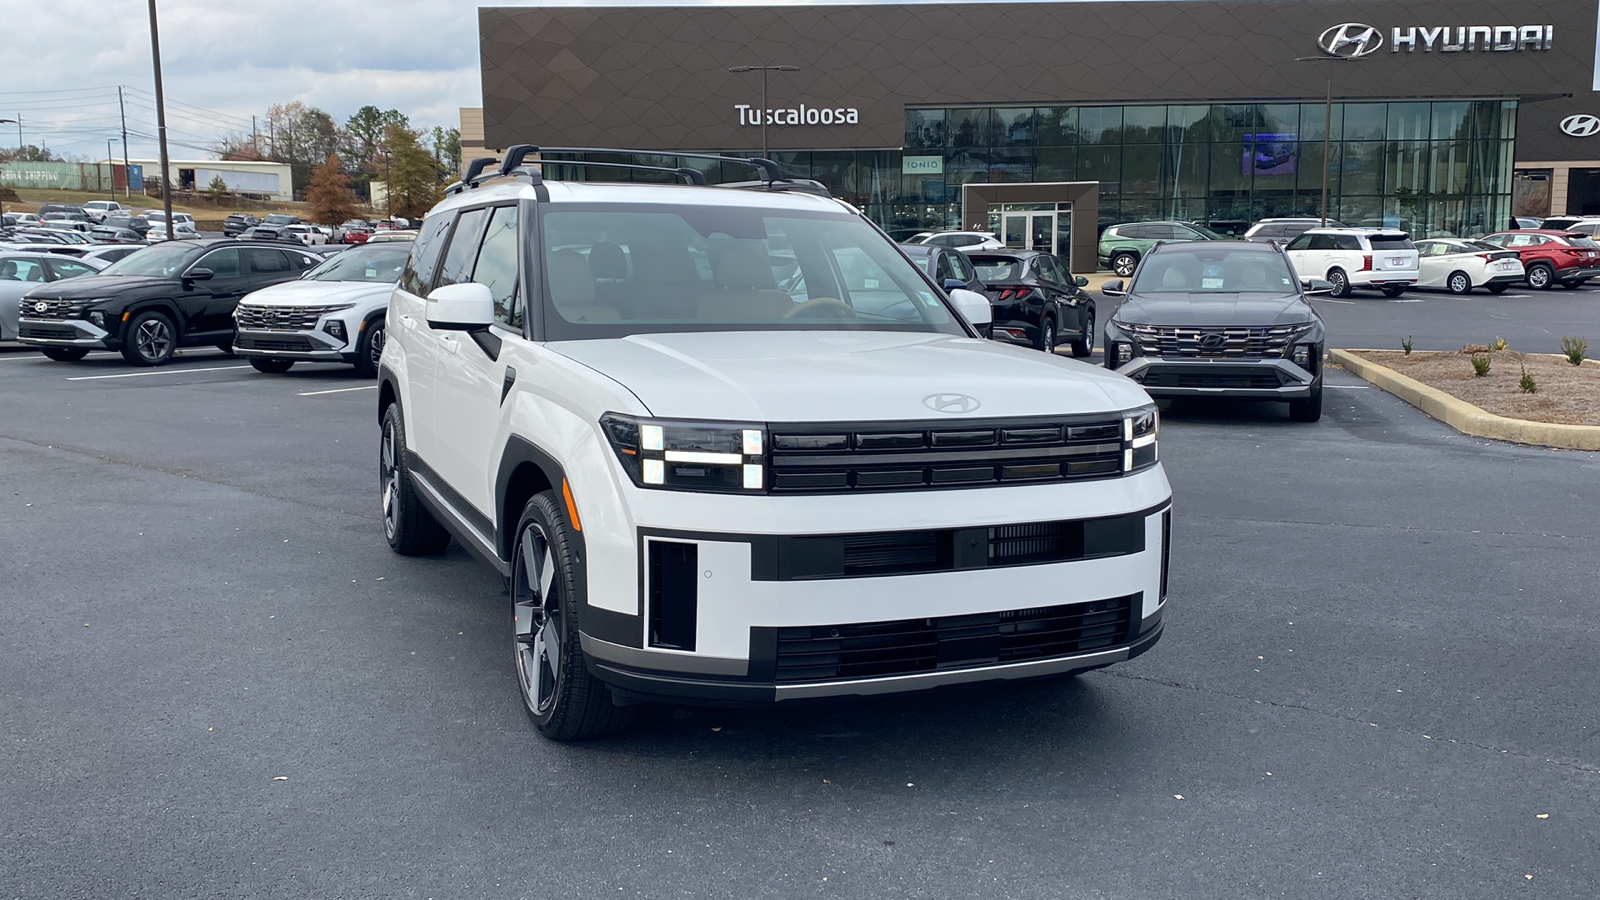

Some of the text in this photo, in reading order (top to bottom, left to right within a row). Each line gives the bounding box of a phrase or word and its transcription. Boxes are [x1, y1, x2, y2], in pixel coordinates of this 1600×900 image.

[1391, 24, 1553, 52] HYUNDAI
[734, 103, 859, 126] Tuscaloosa
[25, 170, 59, 181] SHIPPING
